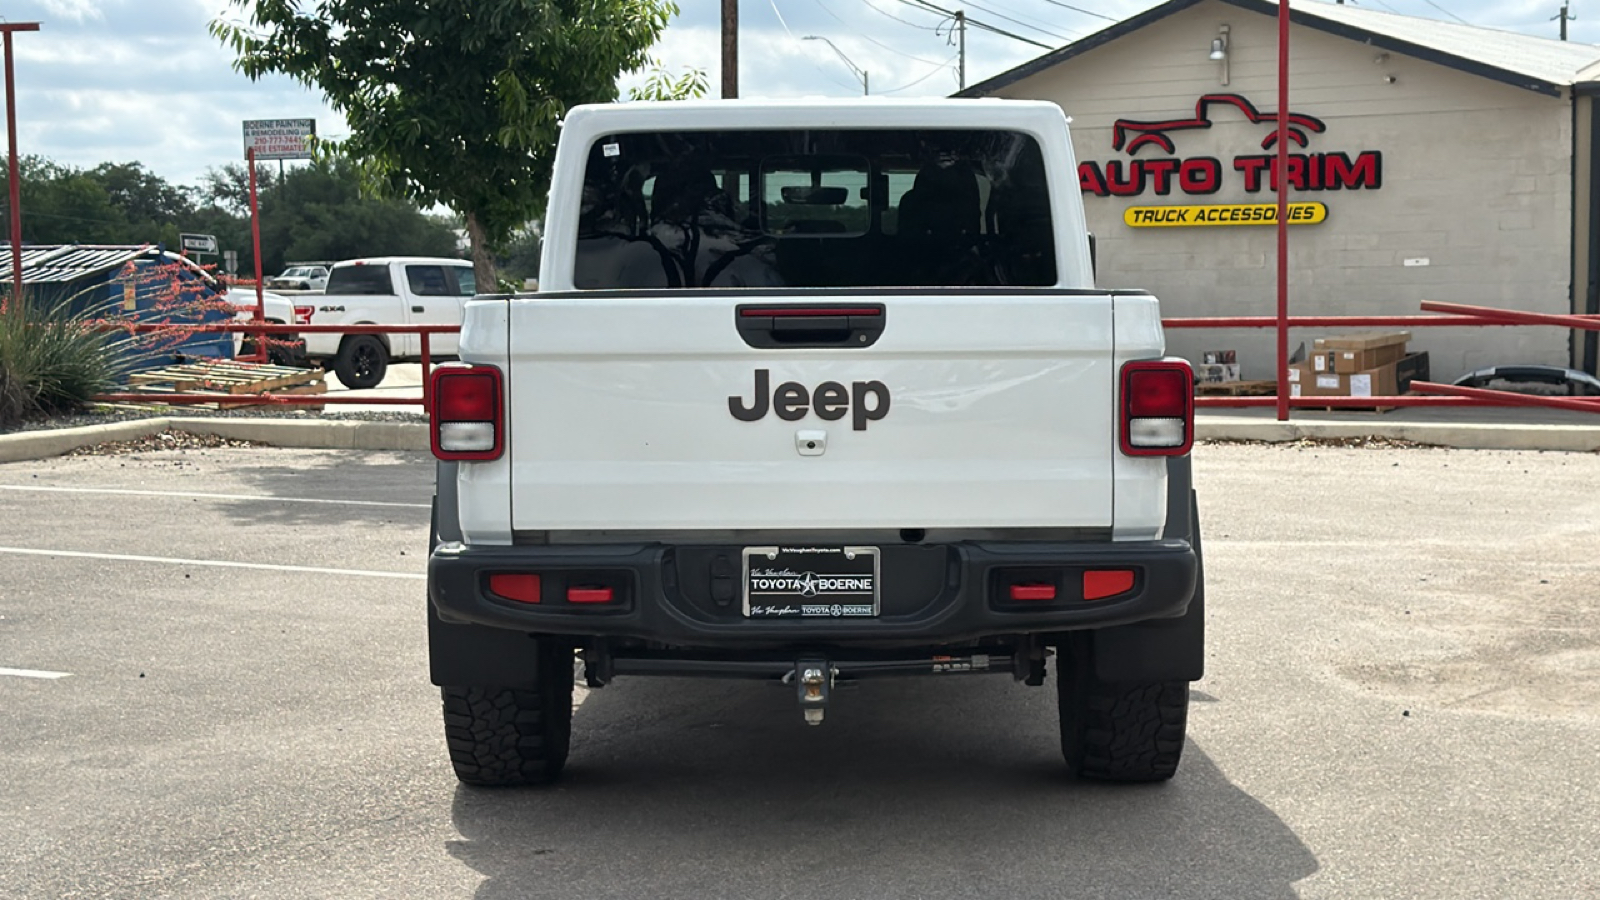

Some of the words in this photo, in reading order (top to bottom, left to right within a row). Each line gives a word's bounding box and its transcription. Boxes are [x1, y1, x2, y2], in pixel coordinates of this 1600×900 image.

[276, 119, 310, 128] PAINTING
[1078, 157, 1222, 197] AUTO
[1233, 150, 1382, 194] TRIM
[1133, 208, 1189, 223] TRUCK
[728, 369, 891, 431] Jeep
[751, 579, 801, 590] TOYOTA
[819, 579, 872, 590] BOERNE
